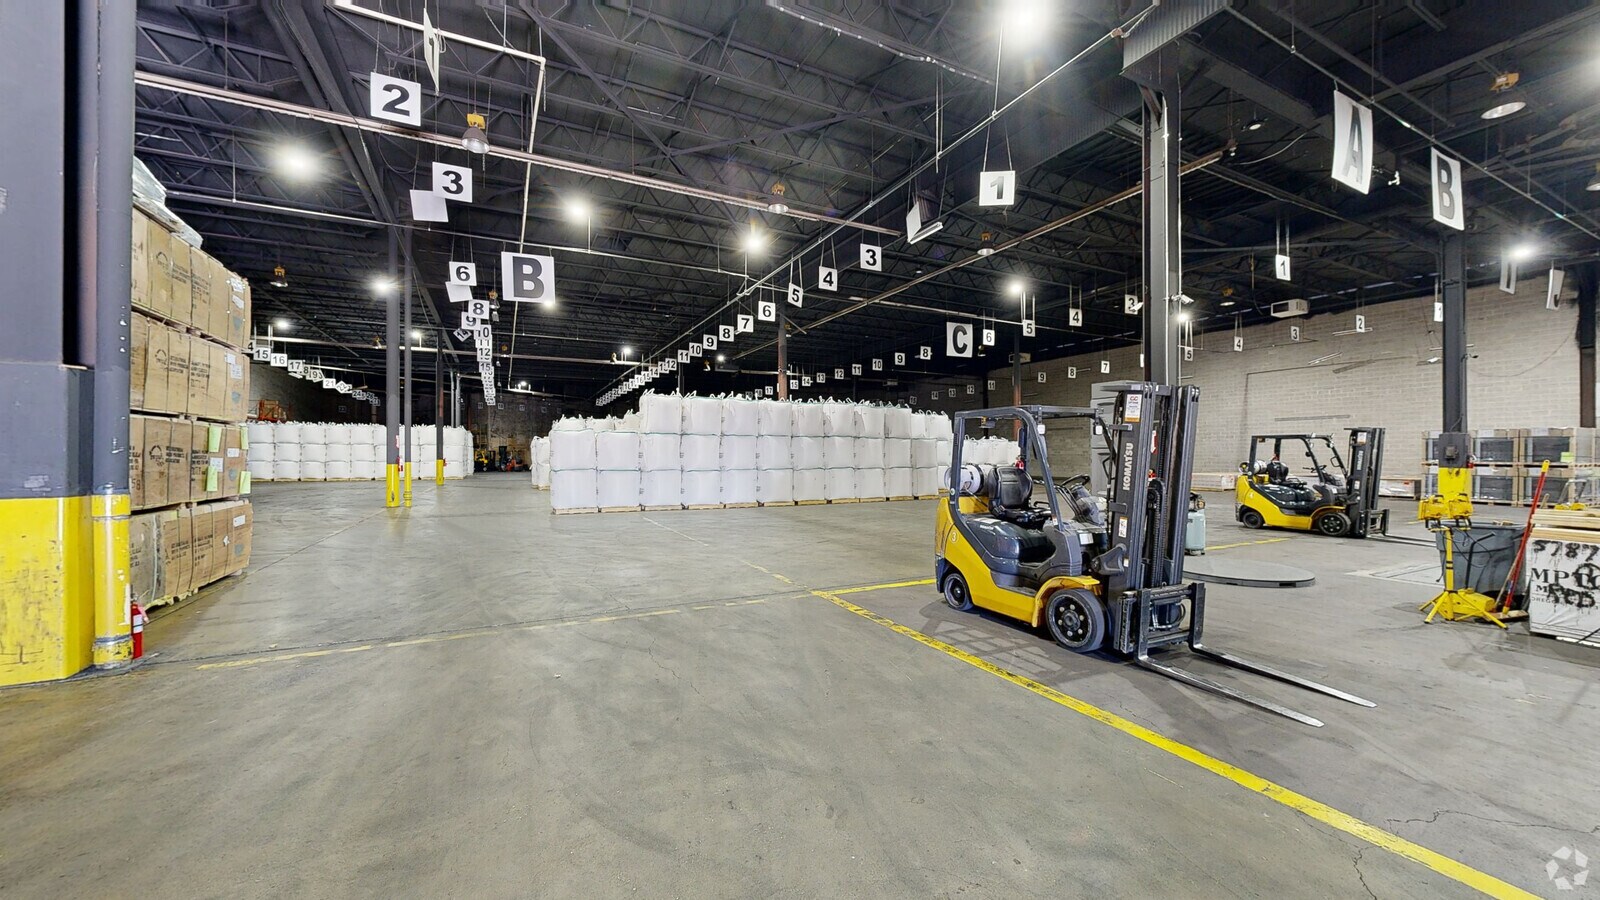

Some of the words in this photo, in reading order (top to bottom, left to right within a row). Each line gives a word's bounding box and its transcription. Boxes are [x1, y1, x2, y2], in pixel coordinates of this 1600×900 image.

[382, 83, 410, 116] 2
[1343, 105, 1363, 184] A
[442, 170, 464, 195] 3
[990, 176, 1004, 200] 1
[1437, 155, 1454, 220] B
[866, 248, 877, 266] 3
[456, 266, 470, 282] 6
[1280, 260, 1287, 278] 1
[512, 256, 544, 298] B
[823, 271, 834, 287] 4
[792, 288, 800, 303] 5
[472, 302, 484, 316] 8
[762, 305, 772, 318] 6
[466, 316, 476, 326] 9
[741, 318, 750, 329] 7
[1072, 312, 1080, 324] 4
[1358, 318, 1363, 329] 2
[476, 327, 490, 338] 10
[722, 328, 730, 338] 8
[1026, 324, 1033, 334] 5
[1293, 328, 1298, 339] 3
[706, 337, 714, 348] 9
[952, 324, 968, 354] C
[986, 332, 992, 342] 6
[690, 344, 700, 354] 10
[1236, 340, 1241, 349] 4
[255, 350, 268, 360] 15
[479, 347, 492, 357] 12
[680, 352, 689, 362] 11
[922, 348, 928, 358] 8
[1187, 350, 1192, 360] 5
[272, 354, 286, 365] 16
[666, 360, 676, 369] 12
[897, 354, 903, 364] 9
[290, 362, 301, 370] 17
[480, 363, 491, 373] 15
[854, 366, 861, 374] 11
[874, 360, 882, 370] 10
[1103, 362, 1108, 370] 7
[836, 370, 844, 378] 12
[1040, 373, 1045, 382] 9
[1069, 368, 1074, 377] 8
[1122, 442, 1134, 491] KOMATSU
